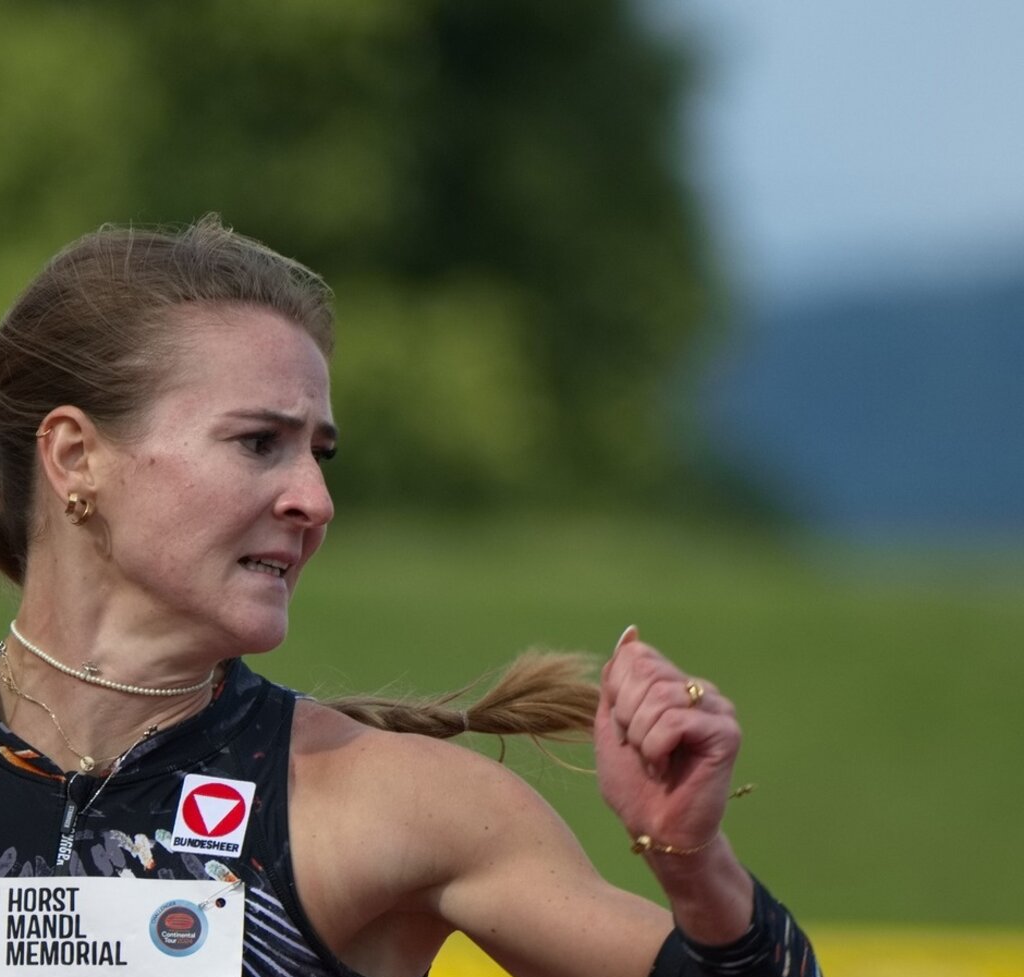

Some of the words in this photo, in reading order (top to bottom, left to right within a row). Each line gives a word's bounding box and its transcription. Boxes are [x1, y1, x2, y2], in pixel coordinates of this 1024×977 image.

[173, 836, 240, 853] BUNDESHEER
[8, 887, 80, 912] HORST
[7, 914, 87, 939] MANDL
[161, 930, 196, 939] Continental
[6, 941, 128, 966] MEMORIAL
